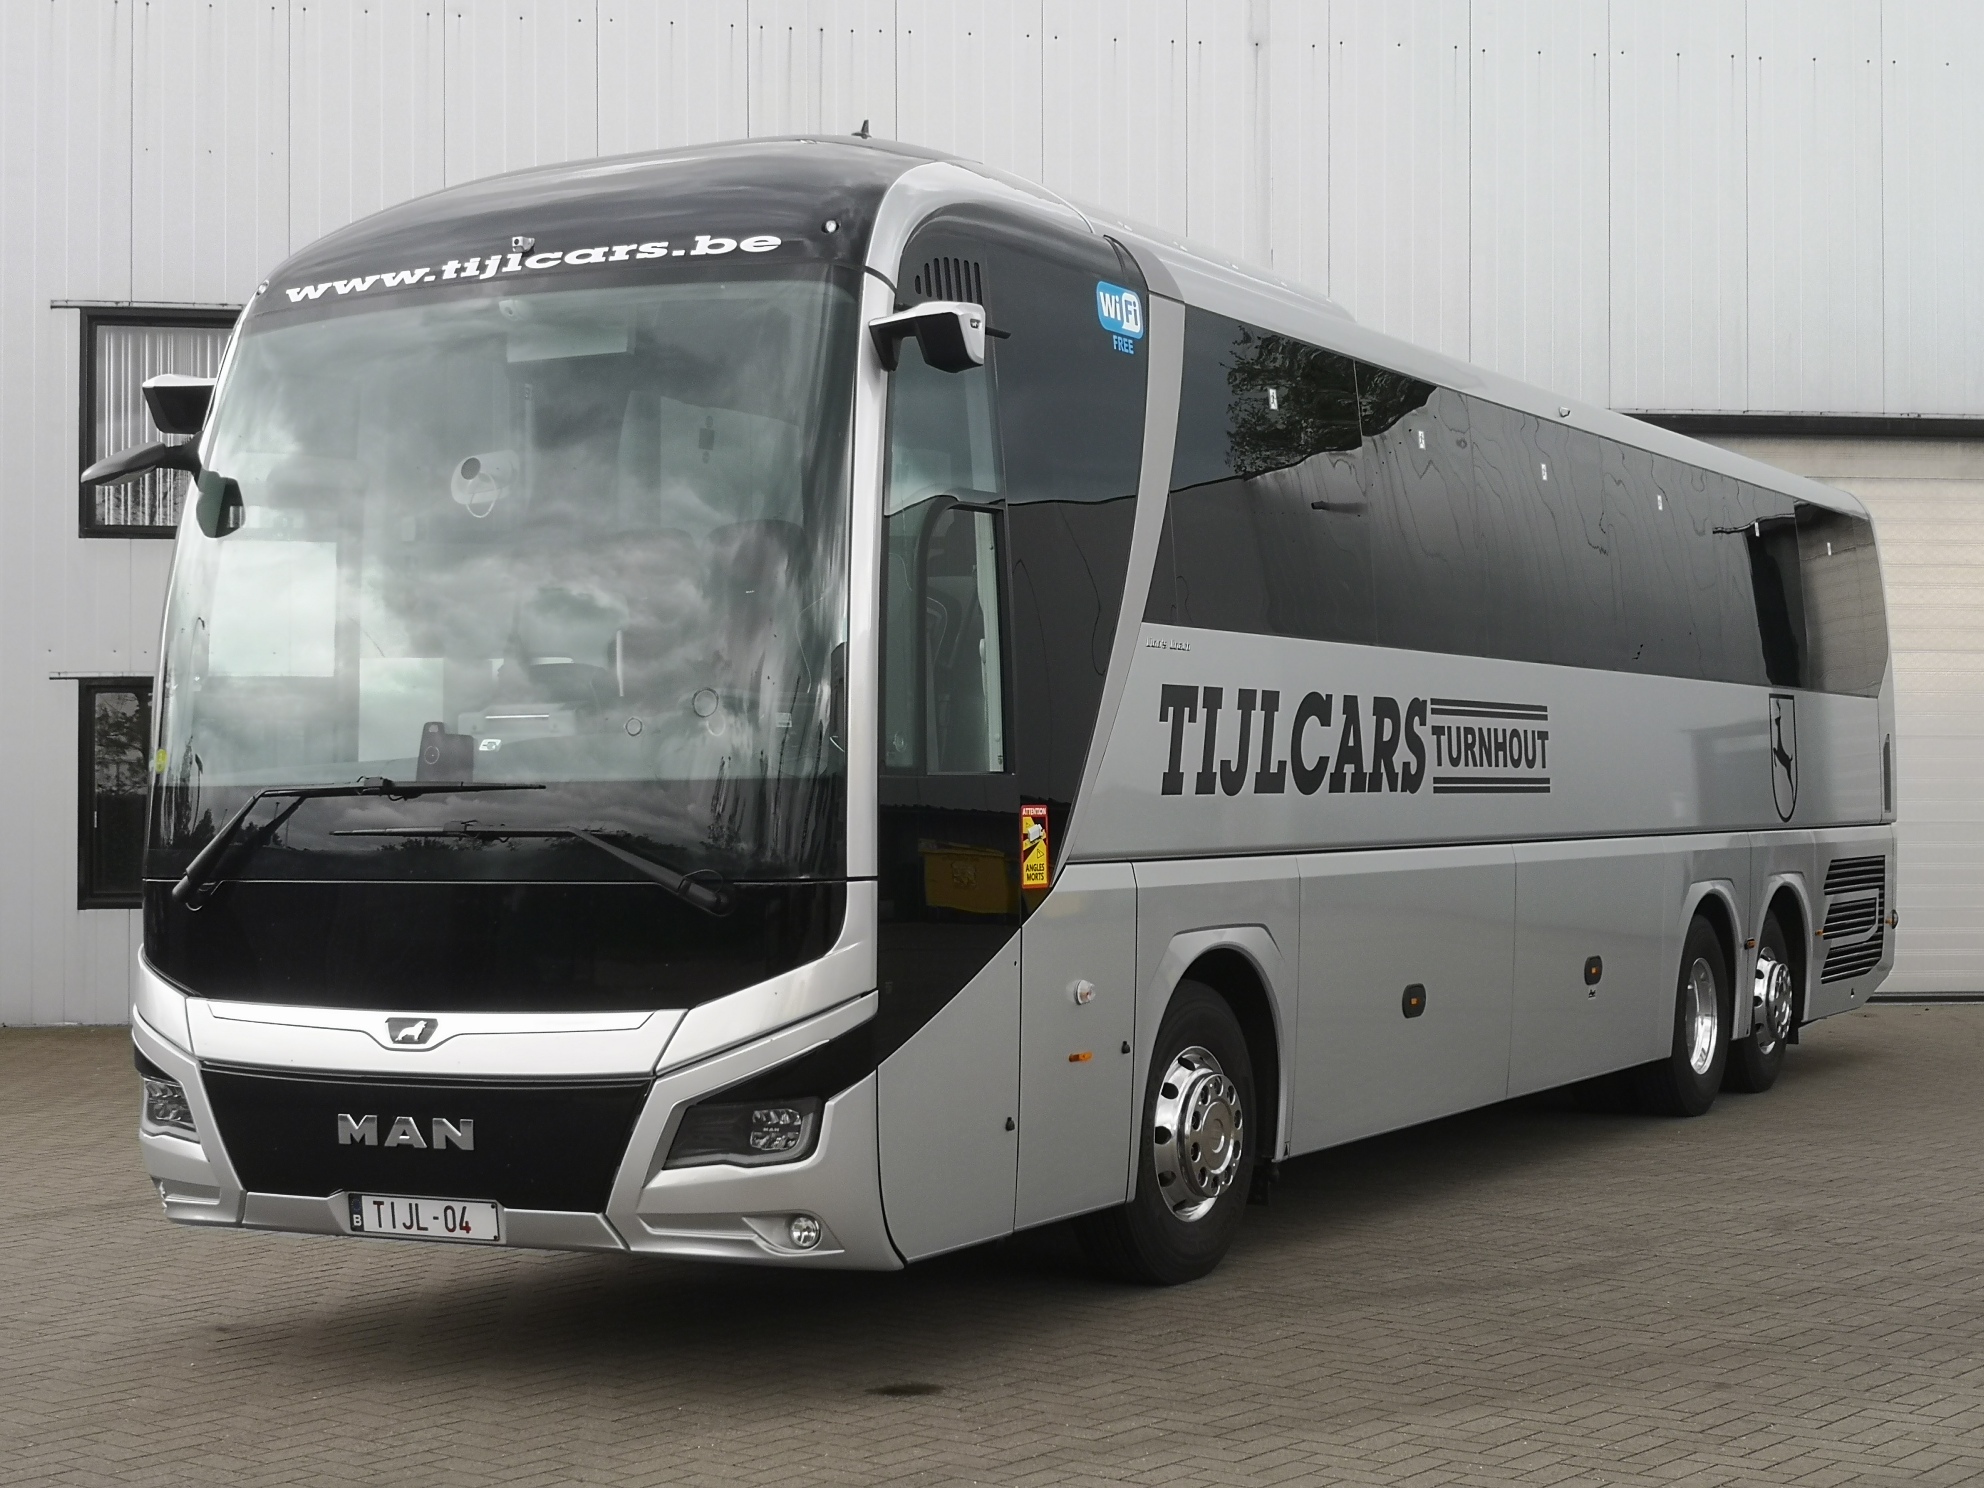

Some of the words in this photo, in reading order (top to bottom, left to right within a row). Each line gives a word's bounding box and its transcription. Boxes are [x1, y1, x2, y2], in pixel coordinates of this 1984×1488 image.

[286, 235, 782, 302] www.tijlcars.be
[1112, 335, 1135, 355] FREE
[1159, 683, 1427, 797] TIJLCARS
[1431, 725, 1550, 769] TURNHOUT
[1022, 807, 1047, 816] ATTENTION
[1025, 863, 1045, 872] ANGLES
[1026, 872, 1045, 881] MORTS
[337, 1113, 475, 1151] MAN
[353, 1214, 362, 1226] B
[372, 1200, 472, 1234] TIJL-04
